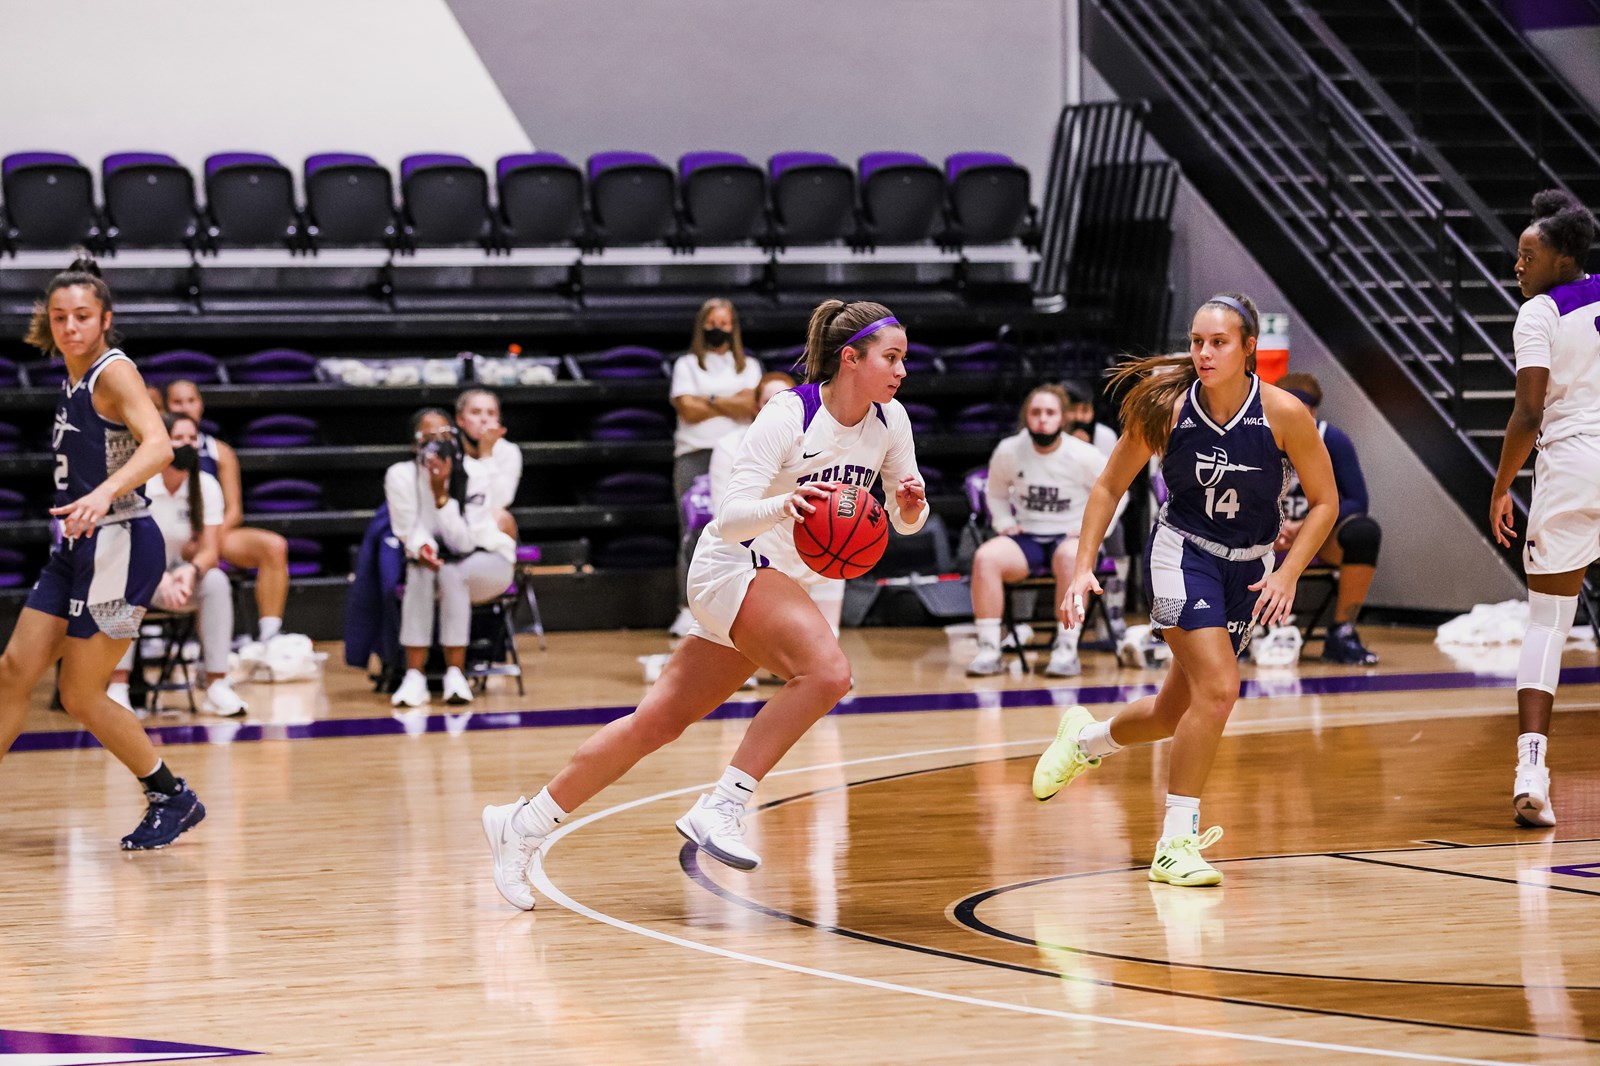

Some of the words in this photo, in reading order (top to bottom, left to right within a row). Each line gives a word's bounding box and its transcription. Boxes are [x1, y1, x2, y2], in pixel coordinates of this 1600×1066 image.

[1243, 417, 1263, 426] WAC
[796, 464, 875, 488] TARLETO
[1204, 487, 1240, 520] 14
